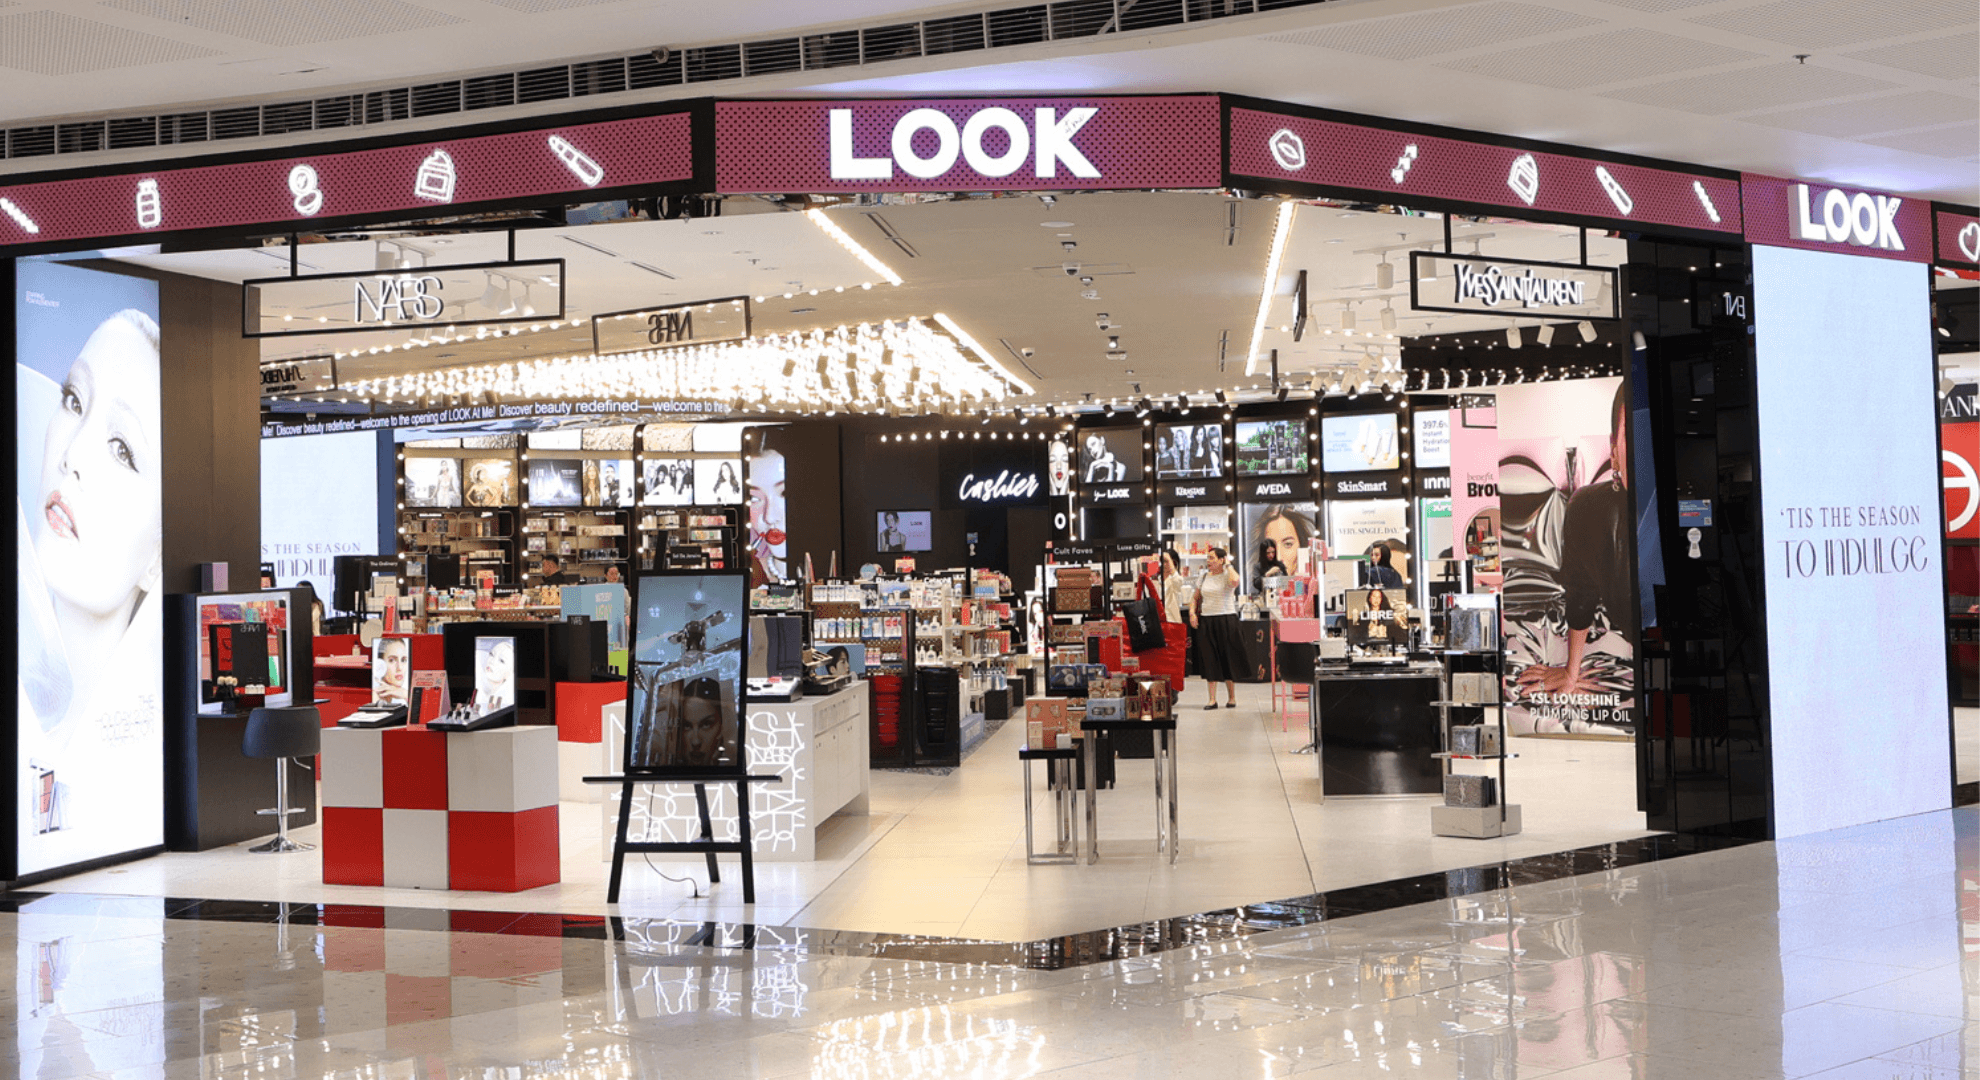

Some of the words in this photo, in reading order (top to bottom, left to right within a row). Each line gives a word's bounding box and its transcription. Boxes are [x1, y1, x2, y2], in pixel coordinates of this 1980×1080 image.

[829, 106, 1102, 179] LOOK
[1797, 183, 1906, 251] LOOK
[354, 276, 443, 323] NARS
[276, 423, 303, 436] Discover
[303, 421, 324, 434] beauty
[390, 416, 398, 426] to
[411, 413, 439, 428] opening
[439, 411, 449, 422] of
[449, 408, 471, 421] LOOK
[482, 406, 496, 418] Me!
[499, 402, 533, 417] Discover
[534, 401, 572, 415] beauty
[704, 400, 713, 412] to
[959, 469, 1039, 502] Cashier
[1255, 483, 1292, 495] AVEDA
[1337, 480, 1388, 494] SkinSmart
[1107, 488, 1130, 499] LOOK
[1820, 506, 1852, 528] THE
[1859, 505, 1921, 527] SEASON
[274, 543, 302, 555] THE
[306, 541, 362, 555] SEASON
[1053, 547, 1070, 555] Cult
[1071, 547, 1094, 555] Faves
[1133, 543, 1151, 551] Gifts
[1777, 539, 1817, 579] TO
[1360, 610, 1394, 621] LIBRE
[1529, 692, 1552, 704] YSL
[1553, 693, 1621, 706] LOVESHINE
[1530, 707, 1590, 721] PLUMPING
[1592, 709, 1610, 721] LIP
[1612, 709, 1632, 722] OIL
